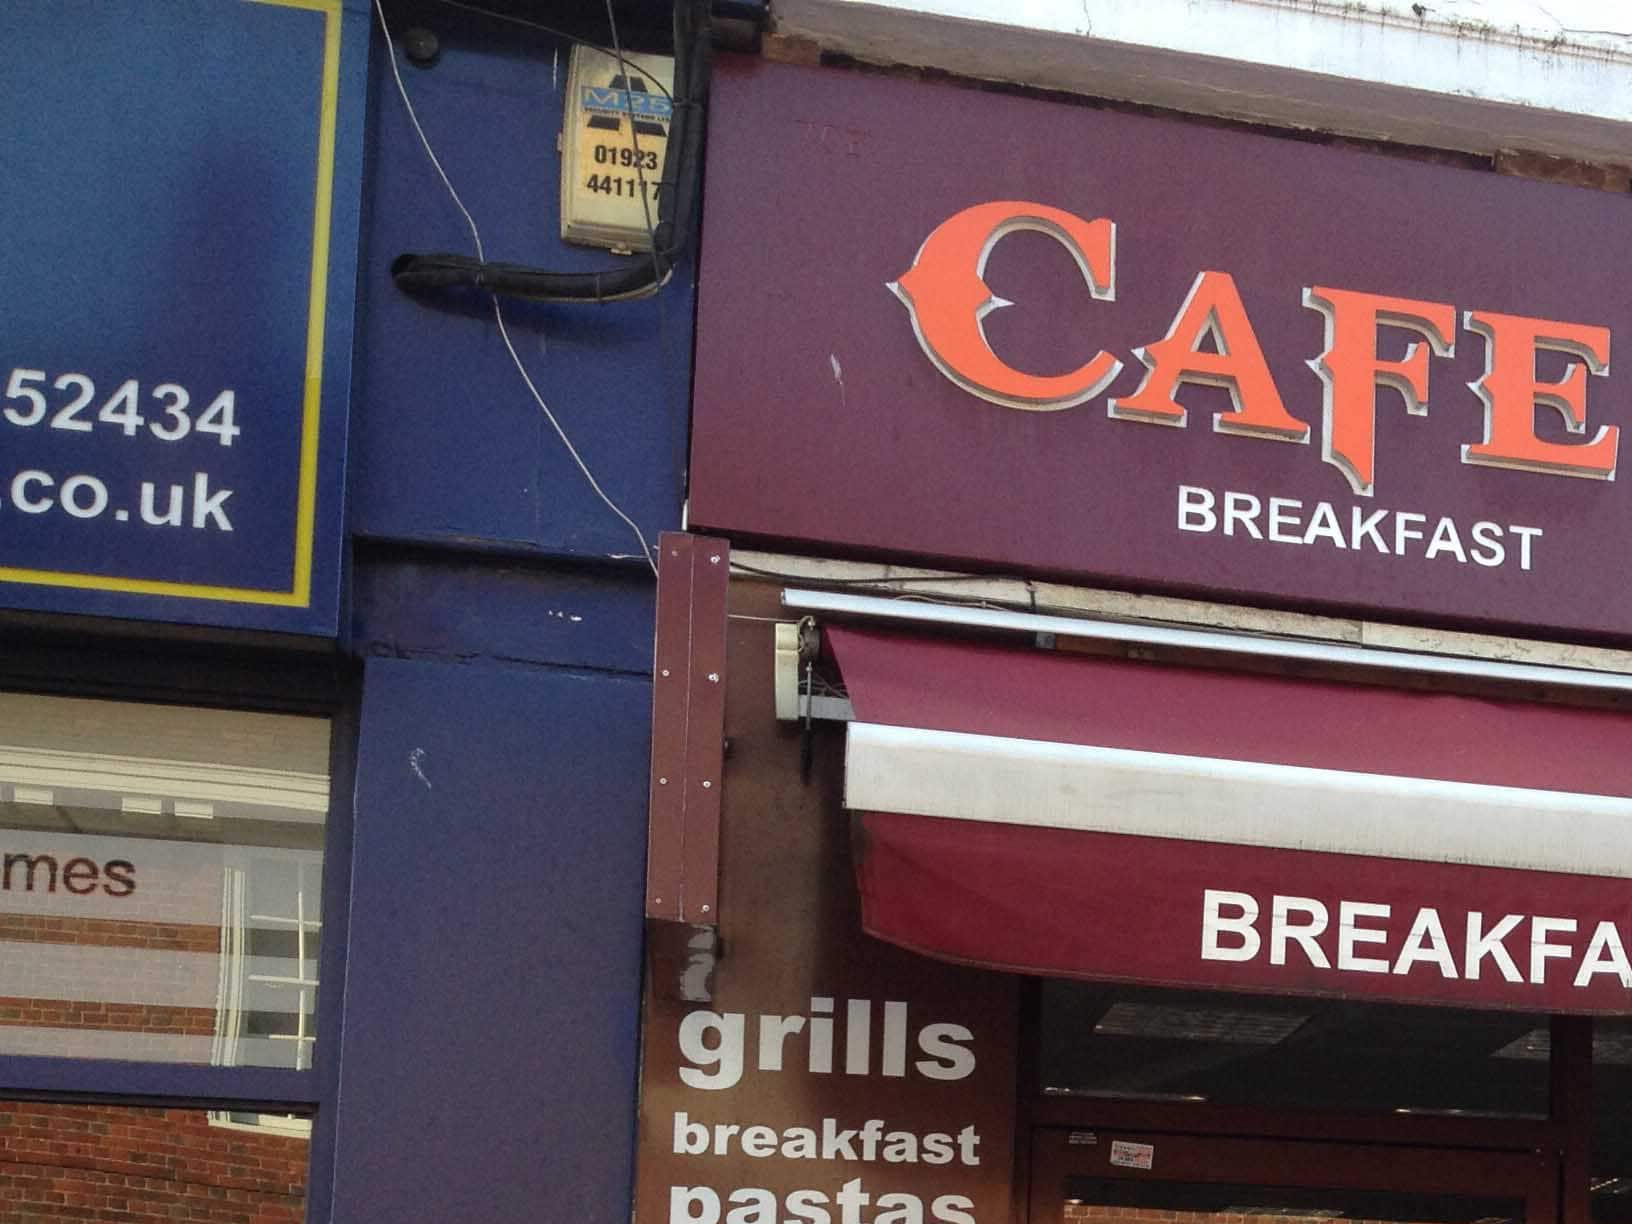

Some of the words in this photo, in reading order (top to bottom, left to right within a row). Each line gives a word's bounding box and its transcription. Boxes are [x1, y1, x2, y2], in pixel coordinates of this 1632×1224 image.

[587, 173, 661, 200] 441117
[594, 145, 658, 171] 01923
[885, 200, 1620, 496] CAFE
[4, 369, 240, 446] 52434
[0, 469, 234, 532] co.uk
[1178, 475, 1542, 569] BREAKFAST
[2, 850, 137, 898] mes
[679, 997, 975, 1090] grills
[673, 1112, 979, 1165] breakfast
